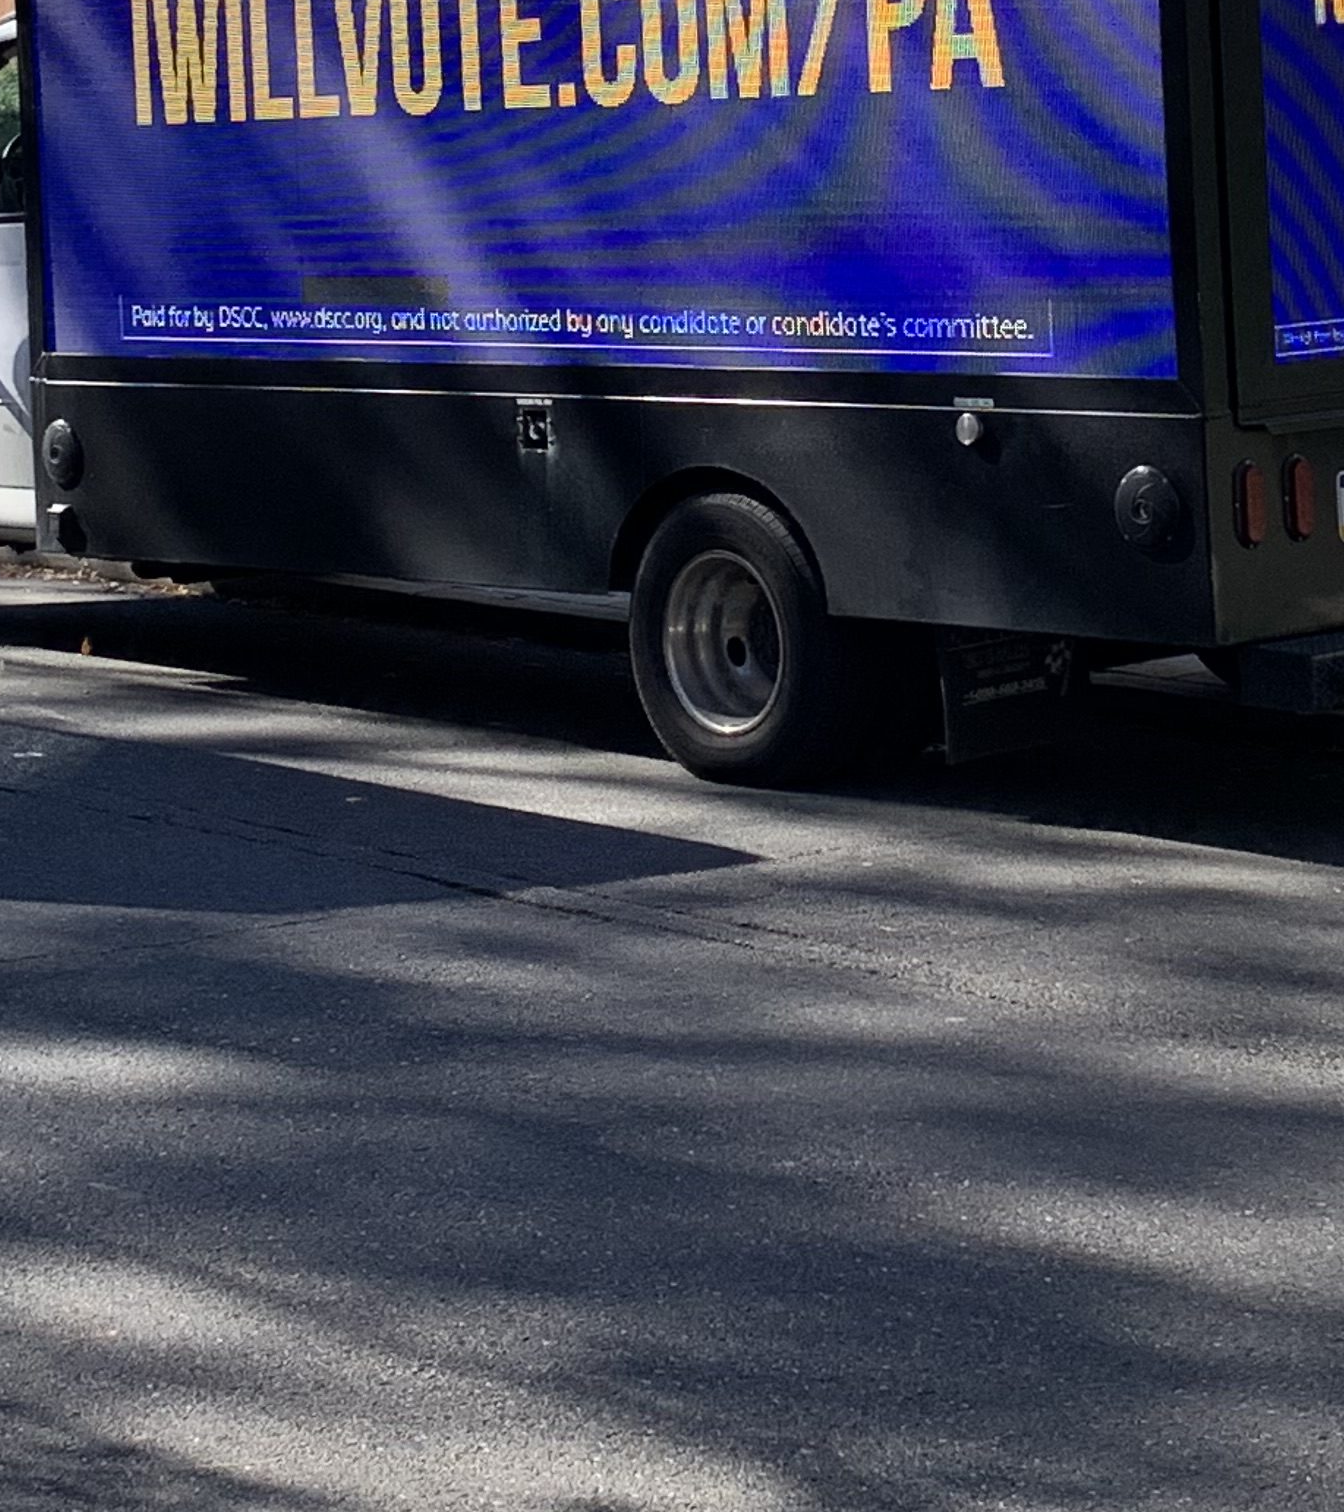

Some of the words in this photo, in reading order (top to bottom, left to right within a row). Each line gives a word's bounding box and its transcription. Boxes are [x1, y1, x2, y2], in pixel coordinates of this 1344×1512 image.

[131, 305, 167, 328] Paid
[168, 305, 192, 328] for
[193, 305, 215, 333] by
[218, 306, 268, 330] DSCC,
[270, 307, 387, 334] www.dscc.org,
[391, 308, 425, 331] and
[430, 309, 460, 331] not
[464, 307, 561, 332] authorized
[566, 309, 593, 338] by
[595, 312, 635, 339] any
[638, 308, 741, 336] candidate
[745, 313, 767, 335] or
[771, 310, 897, 338] candidate's
[902, 312, 1035, 341] committee.
